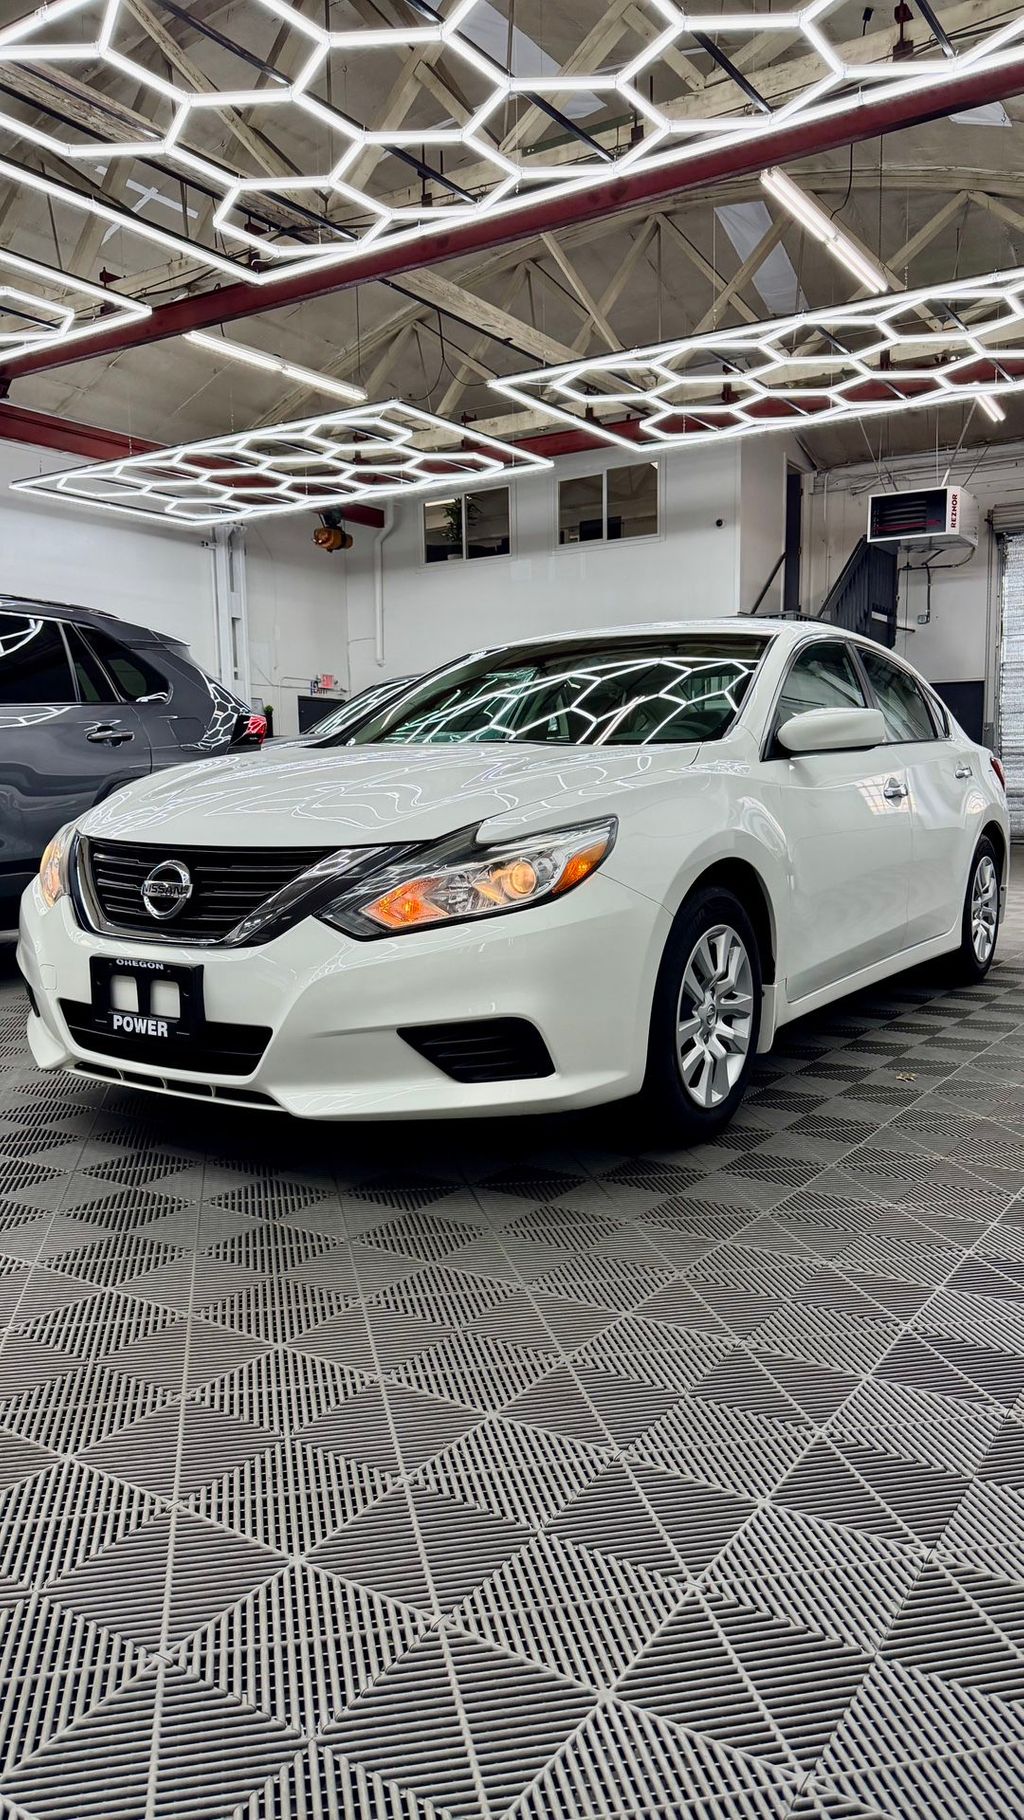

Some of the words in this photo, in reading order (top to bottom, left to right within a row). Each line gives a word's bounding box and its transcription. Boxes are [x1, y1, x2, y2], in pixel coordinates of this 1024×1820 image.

[950, 493, 958, 528] REZNOR
[143, 882, 185, 898] NISSAN
[115, 958, 165, 971] OREGON
[112, 1014, 168, 1038] POWER
